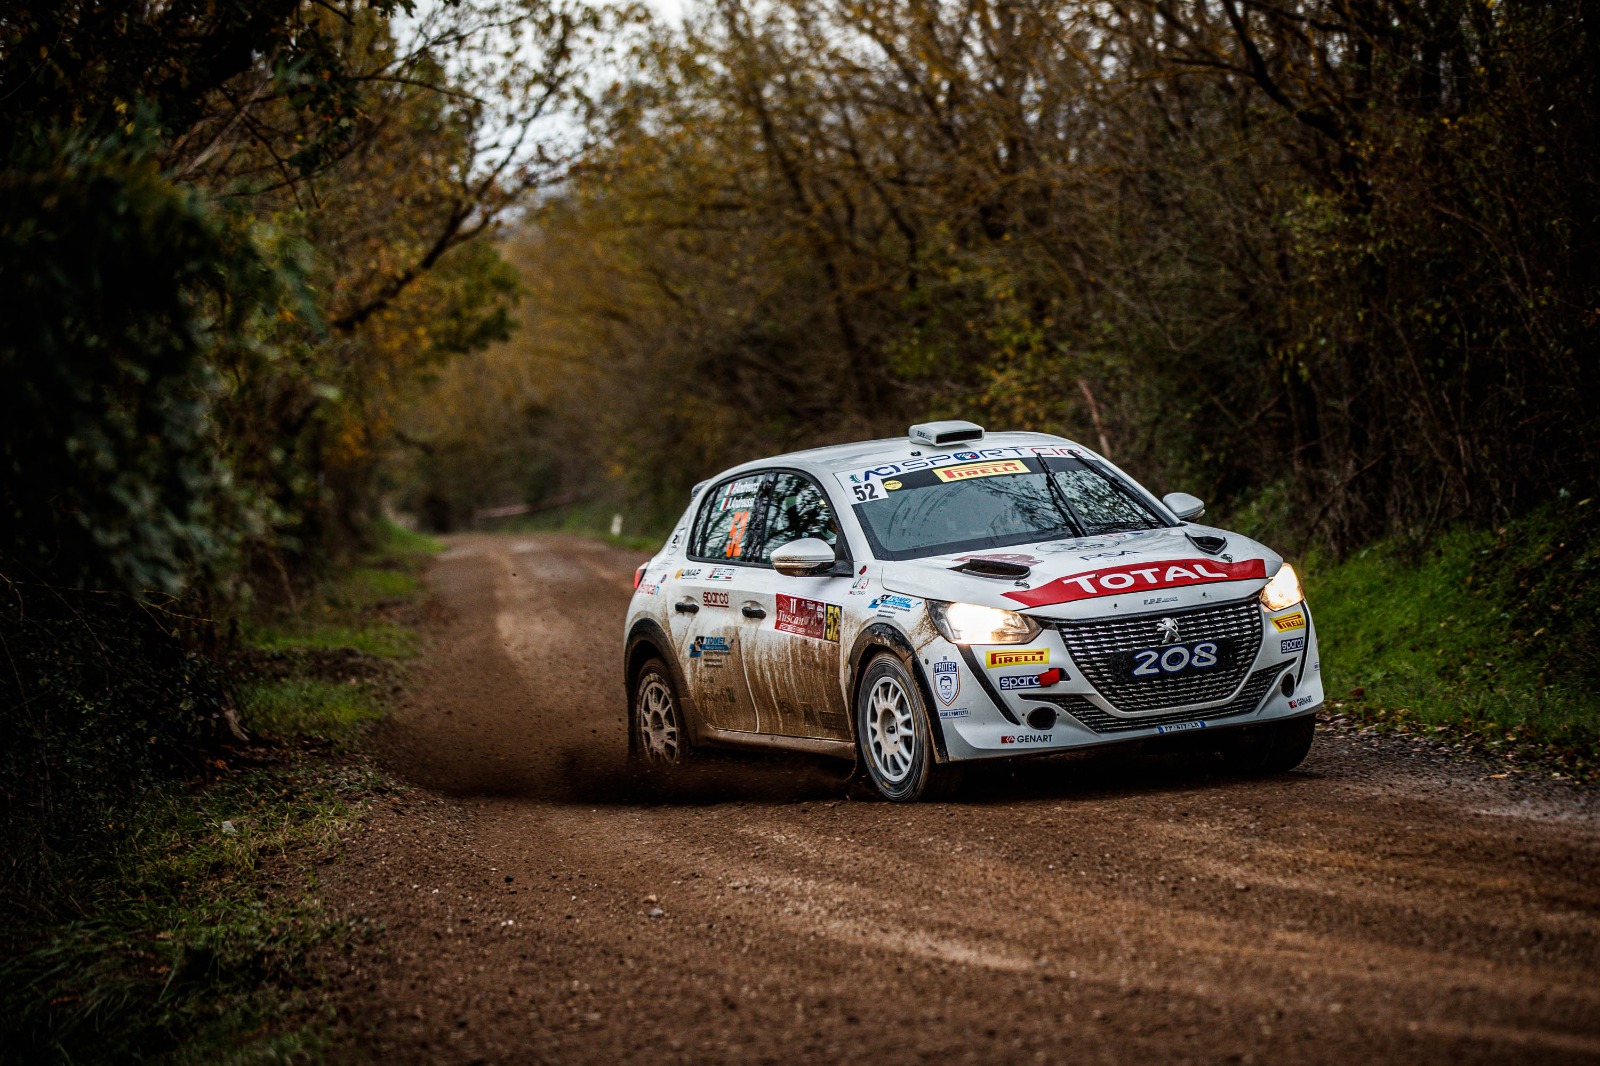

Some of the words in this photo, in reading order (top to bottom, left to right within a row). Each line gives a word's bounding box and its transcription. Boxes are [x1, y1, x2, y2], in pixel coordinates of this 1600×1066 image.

[942, 462, 1020, 479] PIRELLI
[853, 483, 879, 501] 52
[726, 510, 749, 558] 52
[1063, 564, 1229, 594] TOTAL
[703, 591, 730, 608] sparco
[827, 605, 841, 641] 52
[1274, 614, 1305, 630] PIRELLI
[705, 636, 726, 645] TOMEI
[991, 651, 1045, 665] PIRELLI
[1133, 642, 1218, 676] 208
[934, 662, 957, 673] PROTEC
[1000, 676, 1042, 689] sparc
[1017, 734, 1053, 743] GENART
